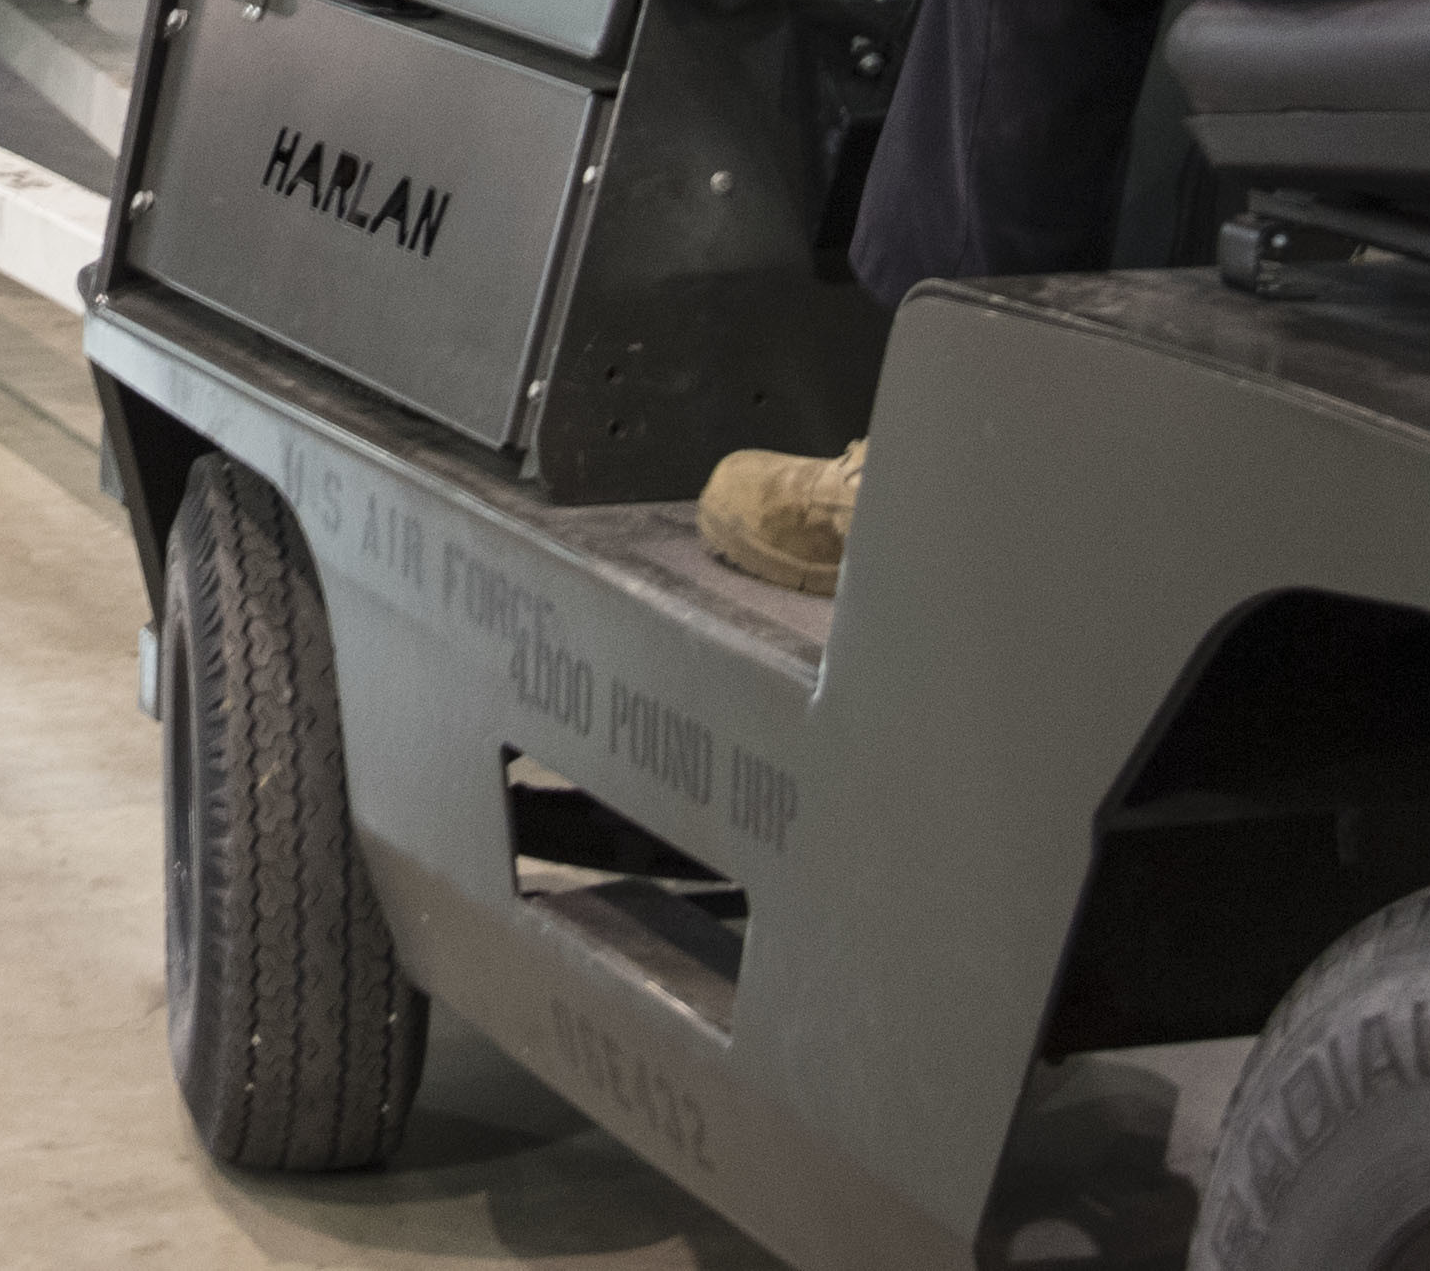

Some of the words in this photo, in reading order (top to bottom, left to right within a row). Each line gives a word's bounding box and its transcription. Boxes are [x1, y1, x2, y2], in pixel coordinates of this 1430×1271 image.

[261, 126, 452, 258] HARLAN
[362, 491, 424, 592] AIR
[609, 675, 714, 806] POUND
